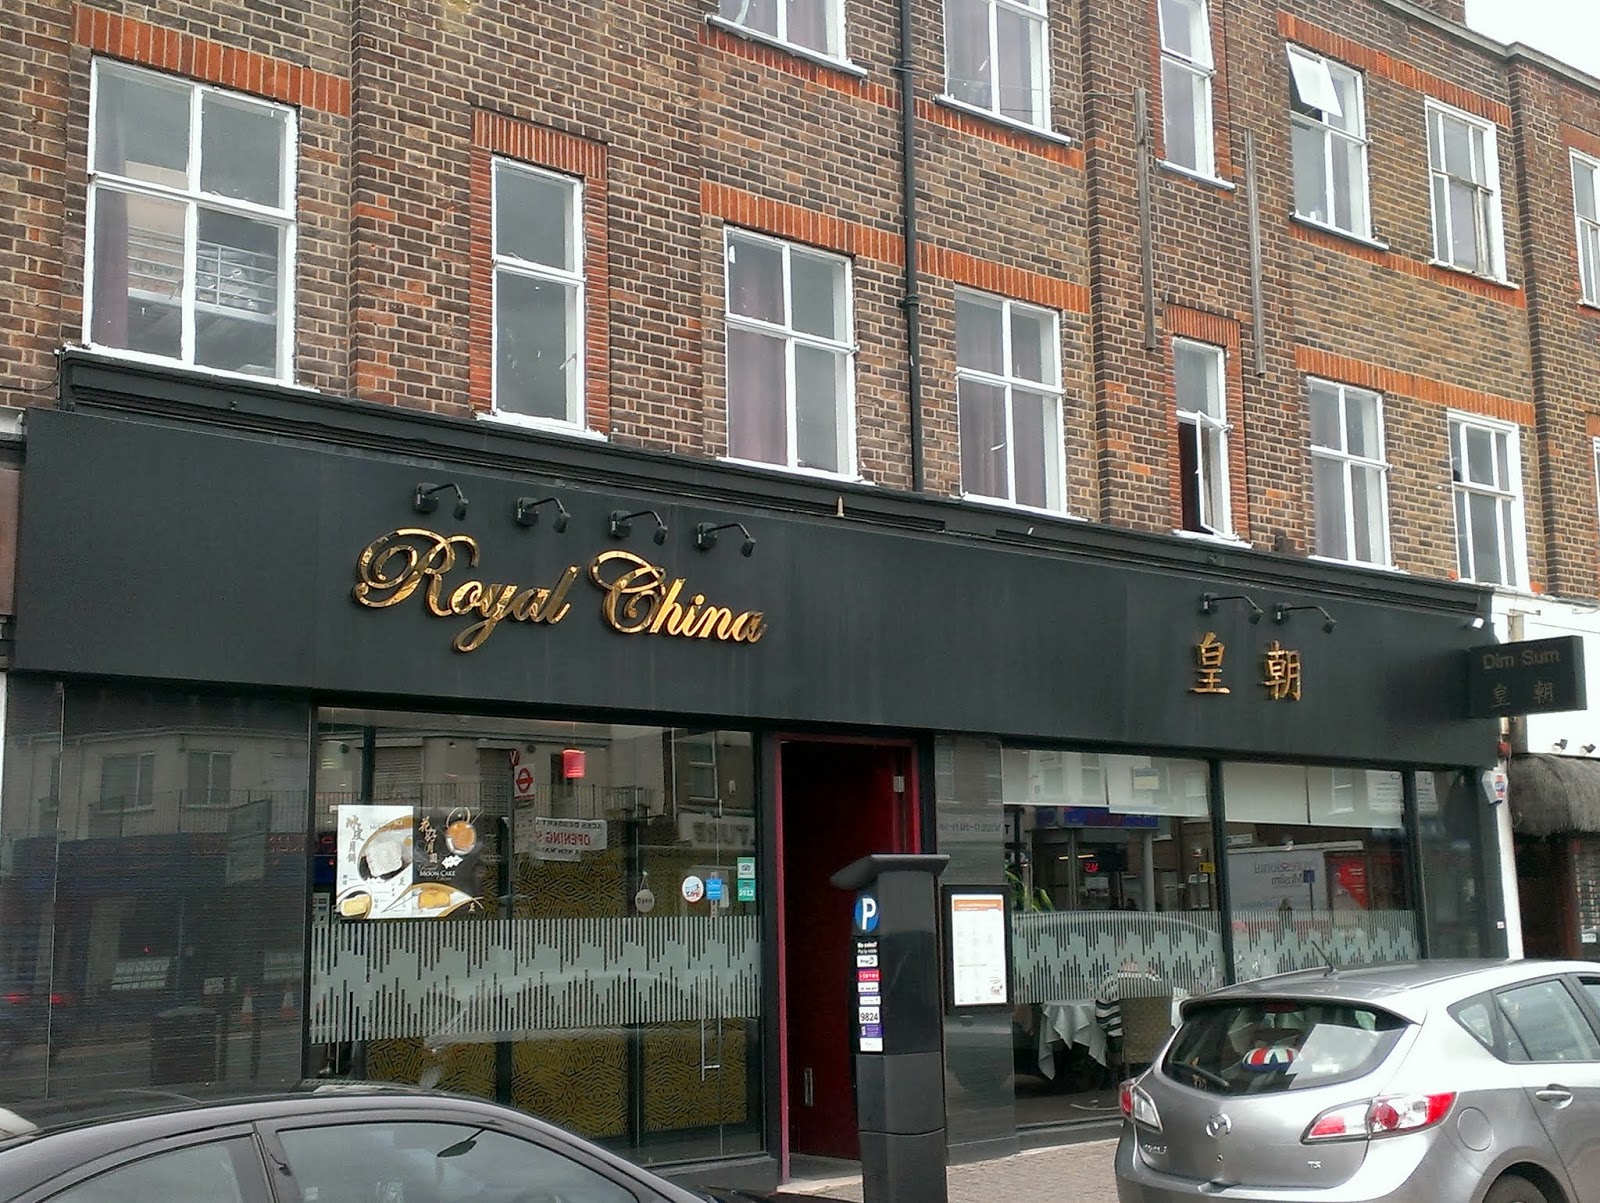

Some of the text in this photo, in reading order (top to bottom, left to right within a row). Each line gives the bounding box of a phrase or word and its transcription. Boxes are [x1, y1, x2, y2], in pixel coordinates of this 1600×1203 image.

[353, 527, 768, 652] Royal China
[1190, 631, 1302, 701] 皇朝
[1482, 649, 1560, 670] Dim Sum
[1492, 680, 1554, 707] 皇朝
[861, 897, 877, 931] P
[860, 1012, 879, 1022] 9824
